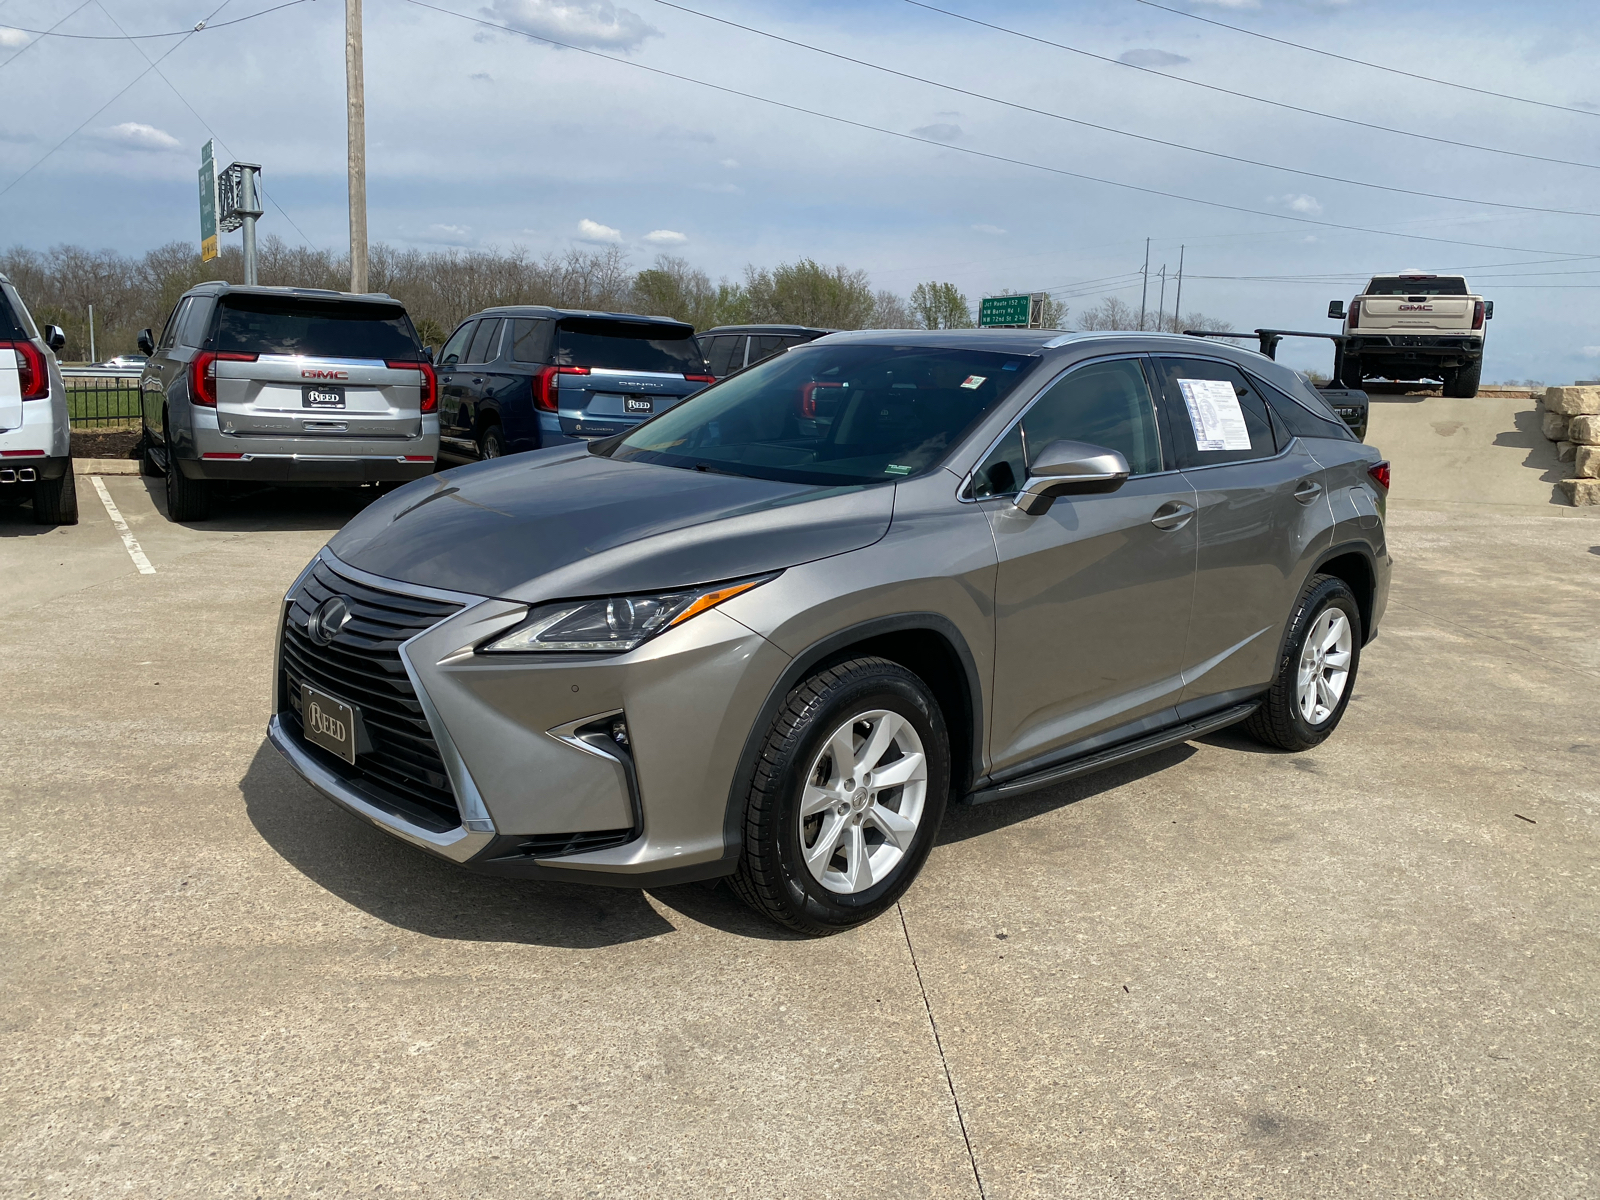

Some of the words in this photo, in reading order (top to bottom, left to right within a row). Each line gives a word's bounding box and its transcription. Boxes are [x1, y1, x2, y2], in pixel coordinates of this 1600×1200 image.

[301, 370, 348, 380] GMC
[308, 391, 339, 403] REED
[628, 400, 650, 409] REED
[308, 702, 346, 742] REED
